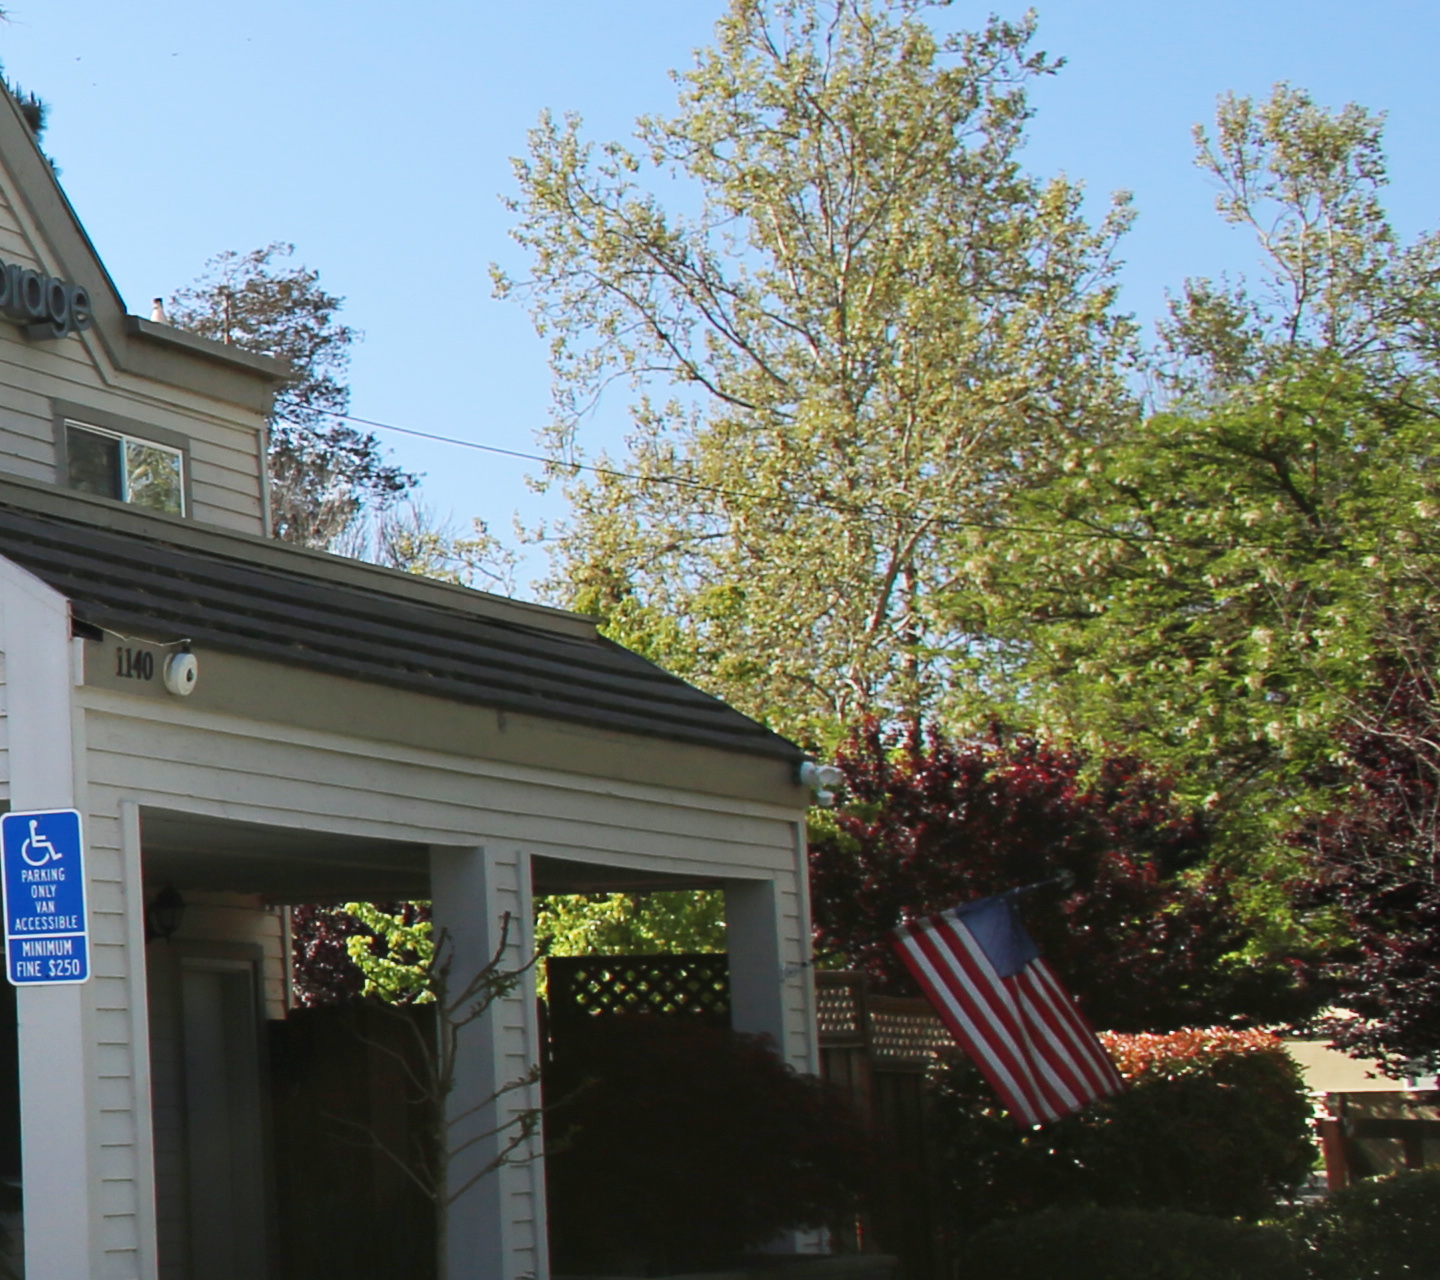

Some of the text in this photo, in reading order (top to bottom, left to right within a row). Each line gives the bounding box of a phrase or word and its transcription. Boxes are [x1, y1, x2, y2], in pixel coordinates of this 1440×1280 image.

[115, 646, 154, 681] 1140
[21, 868, 66, 883] PARKING
[31, 885, 56, 898] ONLY
[35, 901, 55, 914] VAN
[14, 915, 78, 931] ACCESSIBLE
[22, 939, 73, 957] MINIMUM
[16, 959, 80, 977] FINE $250
